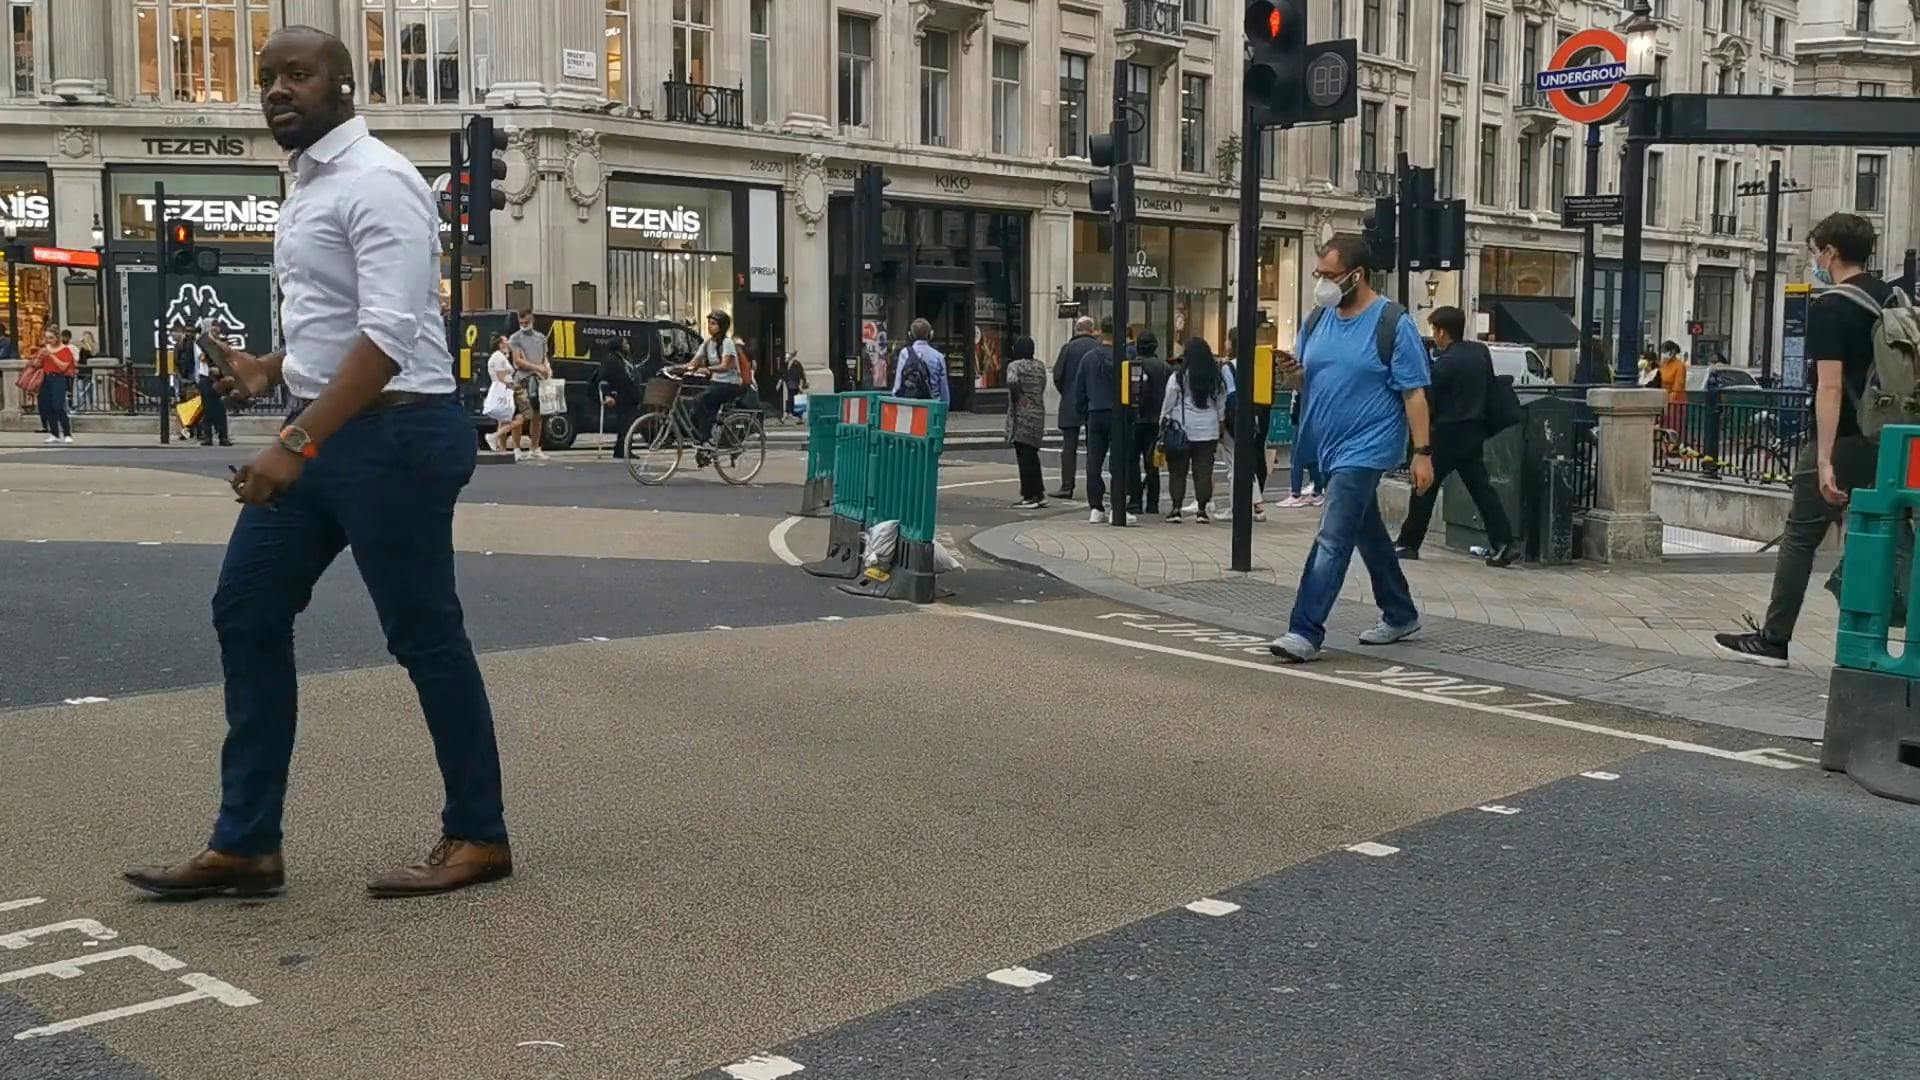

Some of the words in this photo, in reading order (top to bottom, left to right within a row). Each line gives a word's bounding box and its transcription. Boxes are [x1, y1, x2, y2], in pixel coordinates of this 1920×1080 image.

[1540, 66, 1627, 87] UNDERGROUN
[935, 174, 971, 190] KIKO
[1142, 199, 1173, 212] OMEGA
[607, 205, 700, 232] EZENIS
[203, 221, 276, 232] underwea
[643, 230, 699, 240] underwear
[582, 327, 616, 336] ADDISON
